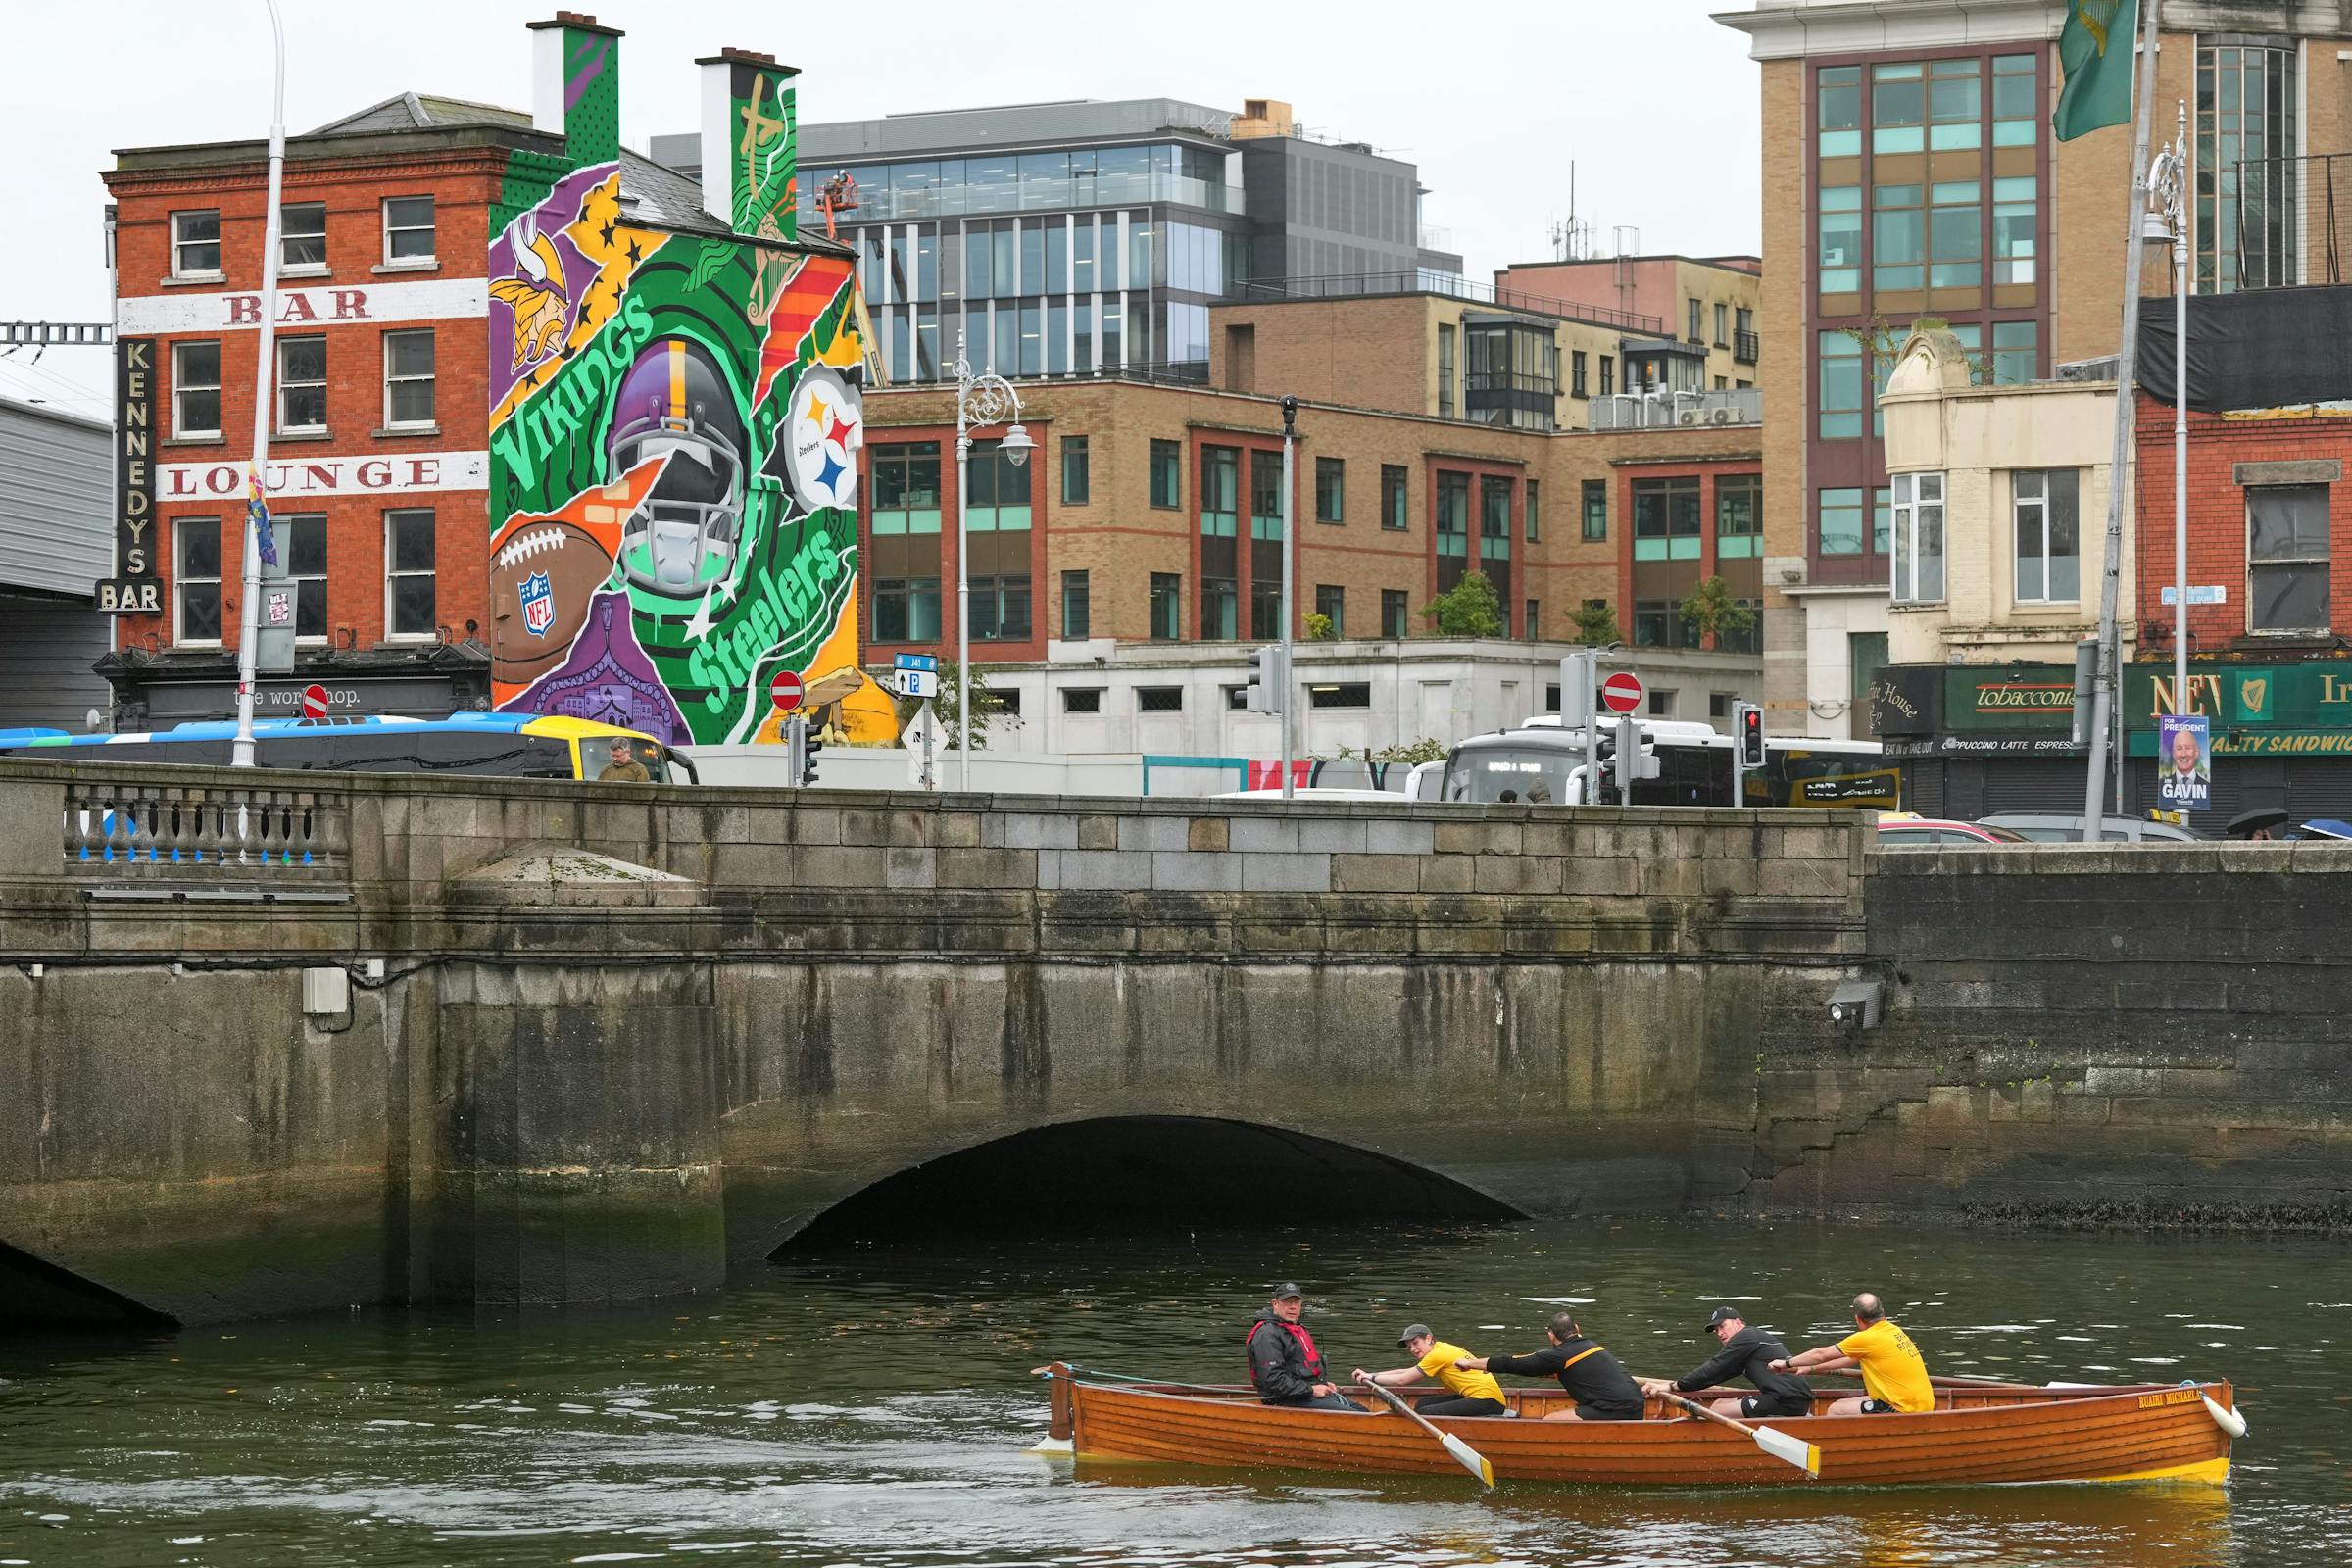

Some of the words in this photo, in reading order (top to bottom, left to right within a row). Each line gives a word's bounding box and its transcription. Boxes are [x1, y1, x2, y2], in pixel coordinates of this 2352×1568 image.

[222, 289, 372, 325] BAR
[492, 294, 654, 492] VIKINGS
[125, 343, 150, 575] KENNEDYS
[167, 460, 440, 495] LOUNGE
[101, 585, 161, 610] BAR
[527, 599, 552, 626] NFL
[689, 530, 839, 714] Steelers
[910, 658, 921, 667] J41
[233, 688, 264, 706] te
[270, 686, 361, 707] worhop.
[1882, 682, 1918, 718] House
[1978, 685, 2076, 706] tobacconi
[2164, 723, 2205, 732] PRESIDENT
[1941, 740, 1998, 750] CPPUCCINO
[2000, 741, 2029, 750] LATTE
[2034, 741, 2074, 750] ESPRESS
[2162, 784, 2207, 799] GAVIN
